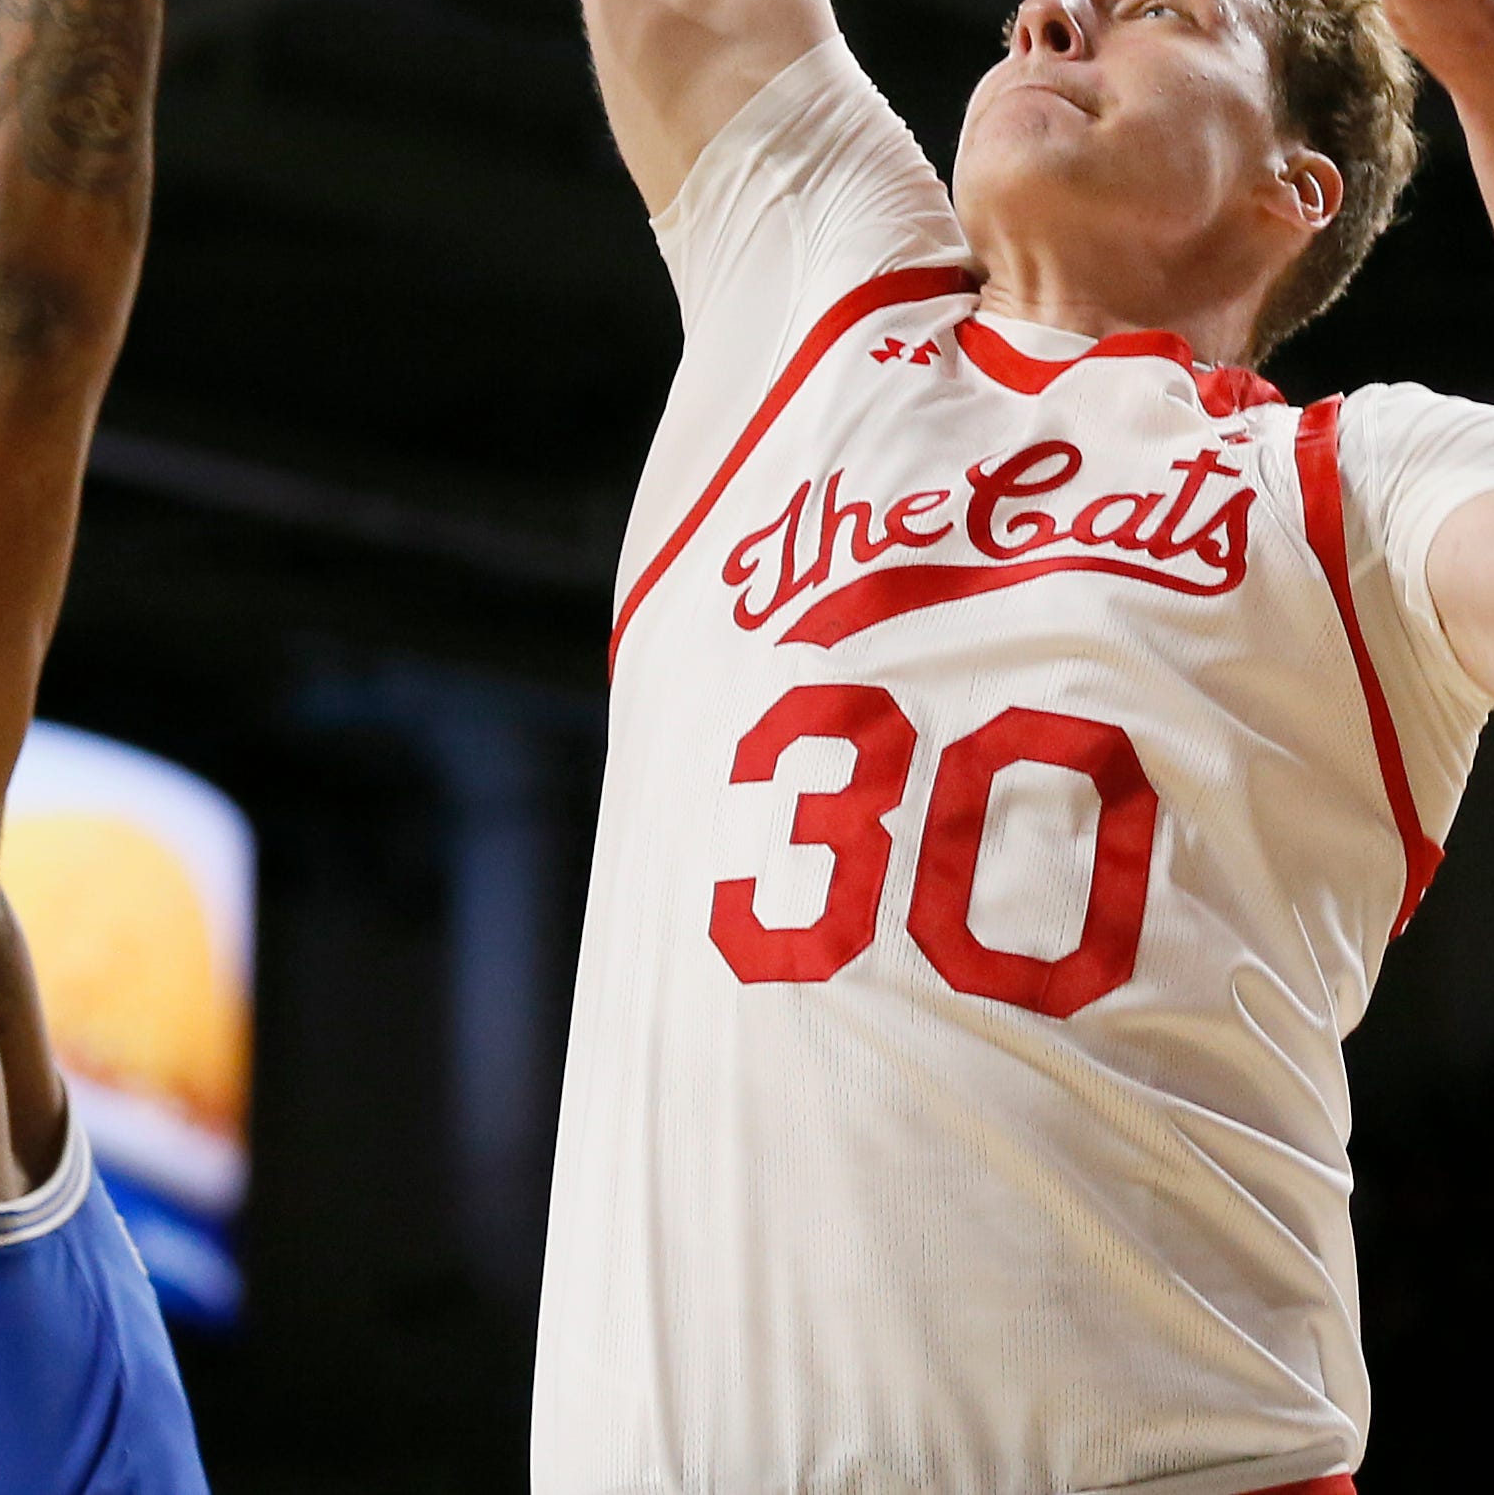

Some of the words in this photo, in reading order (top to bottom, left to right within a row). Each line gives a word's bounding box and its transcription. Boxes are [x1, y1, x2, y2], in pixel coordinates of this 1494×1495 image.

[722, 468, 954, 631] The
[966, 441, 1259, 590] Cats
[708, 684, 1159, 1019] 30
